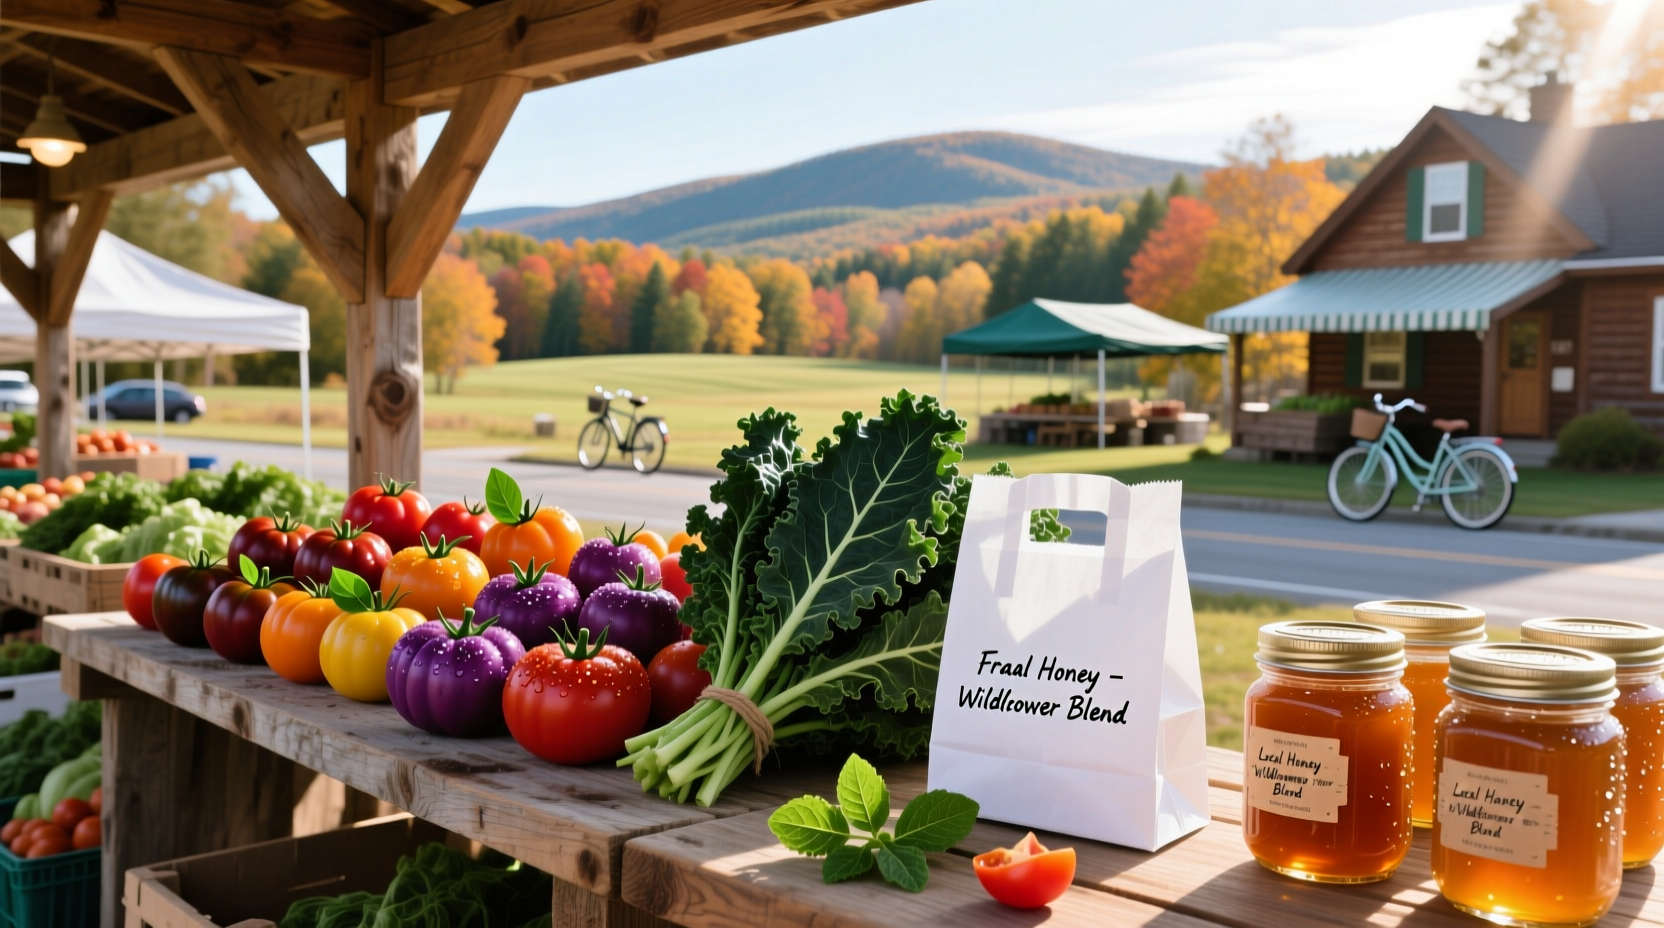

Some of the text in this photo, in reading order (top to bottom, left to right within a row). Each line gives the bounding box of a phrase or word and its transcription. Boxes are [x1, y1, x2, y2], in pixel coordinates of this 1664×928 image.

[977, 650, 1033, 678] Fraal
[1037, 656, 1100, 694] Honey
[1066, 695, 1130, 725] Blend
